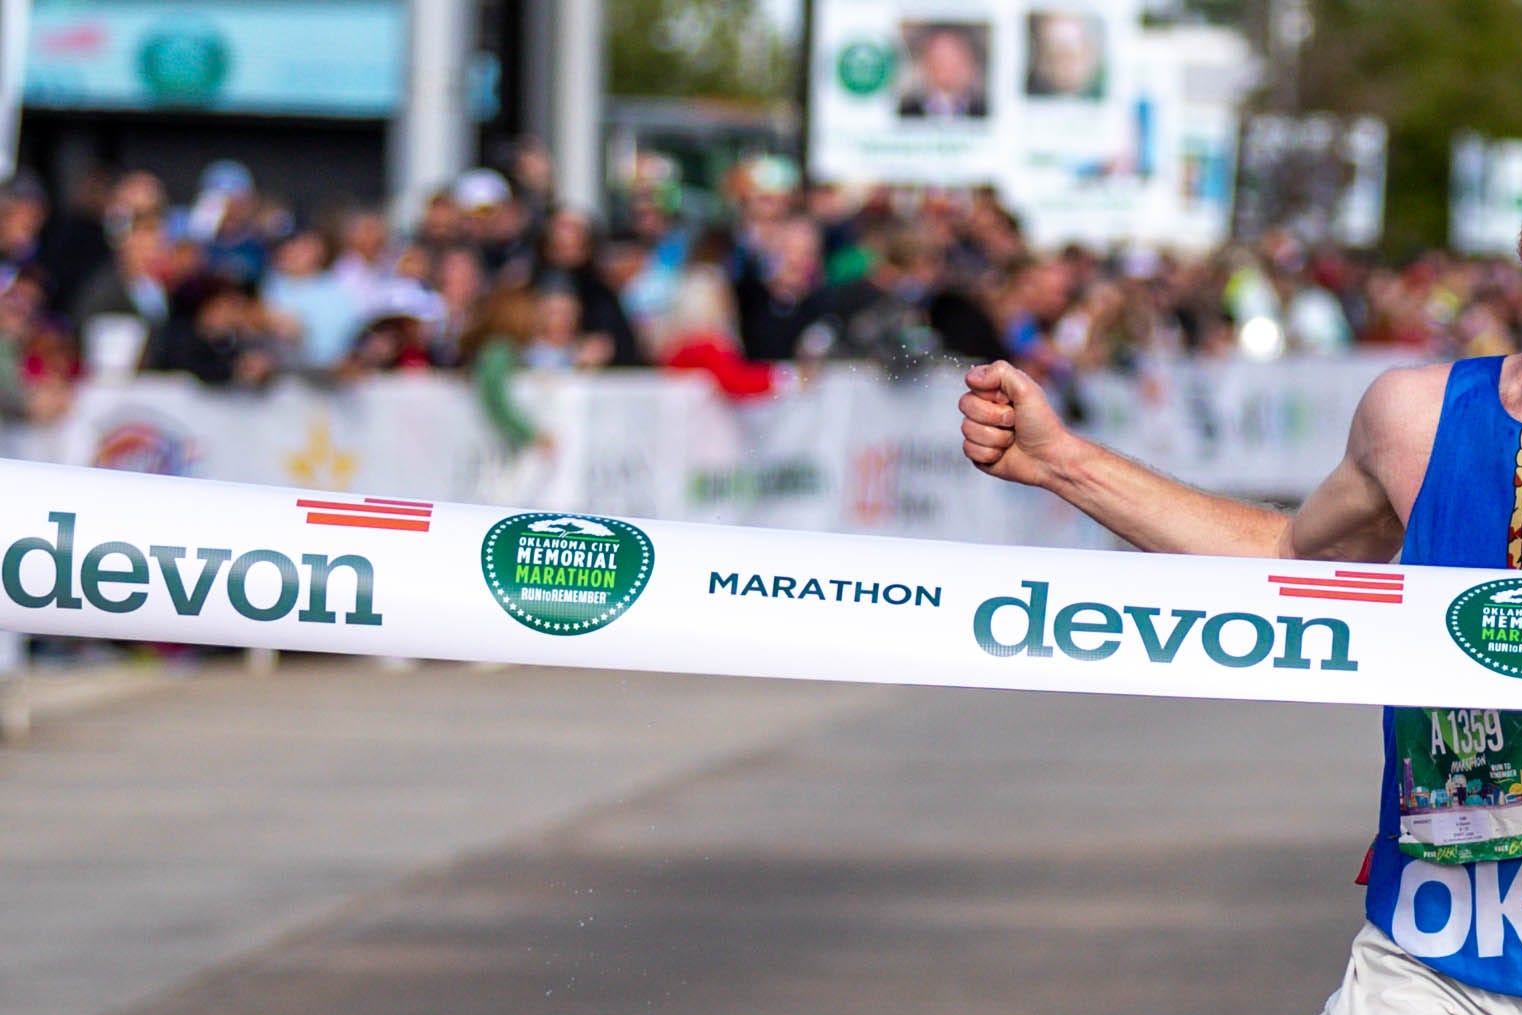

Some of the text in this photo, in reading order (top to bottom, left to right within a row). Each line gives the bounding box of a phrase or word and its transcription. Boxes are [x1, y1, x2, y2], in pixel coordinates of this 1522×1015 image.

[516, 547, 617, 570] MEMORIAL
[519, 537, 620, 553] OKLAHOMA CITY
[2, 511, 383, 626] devon
[515, 565, 616, 588] MARATHON
[708, 571, 942, 607] MARATHON
[972, 580, 1358, 671] devon
[1431, 709, 1504, 755] A 1359
